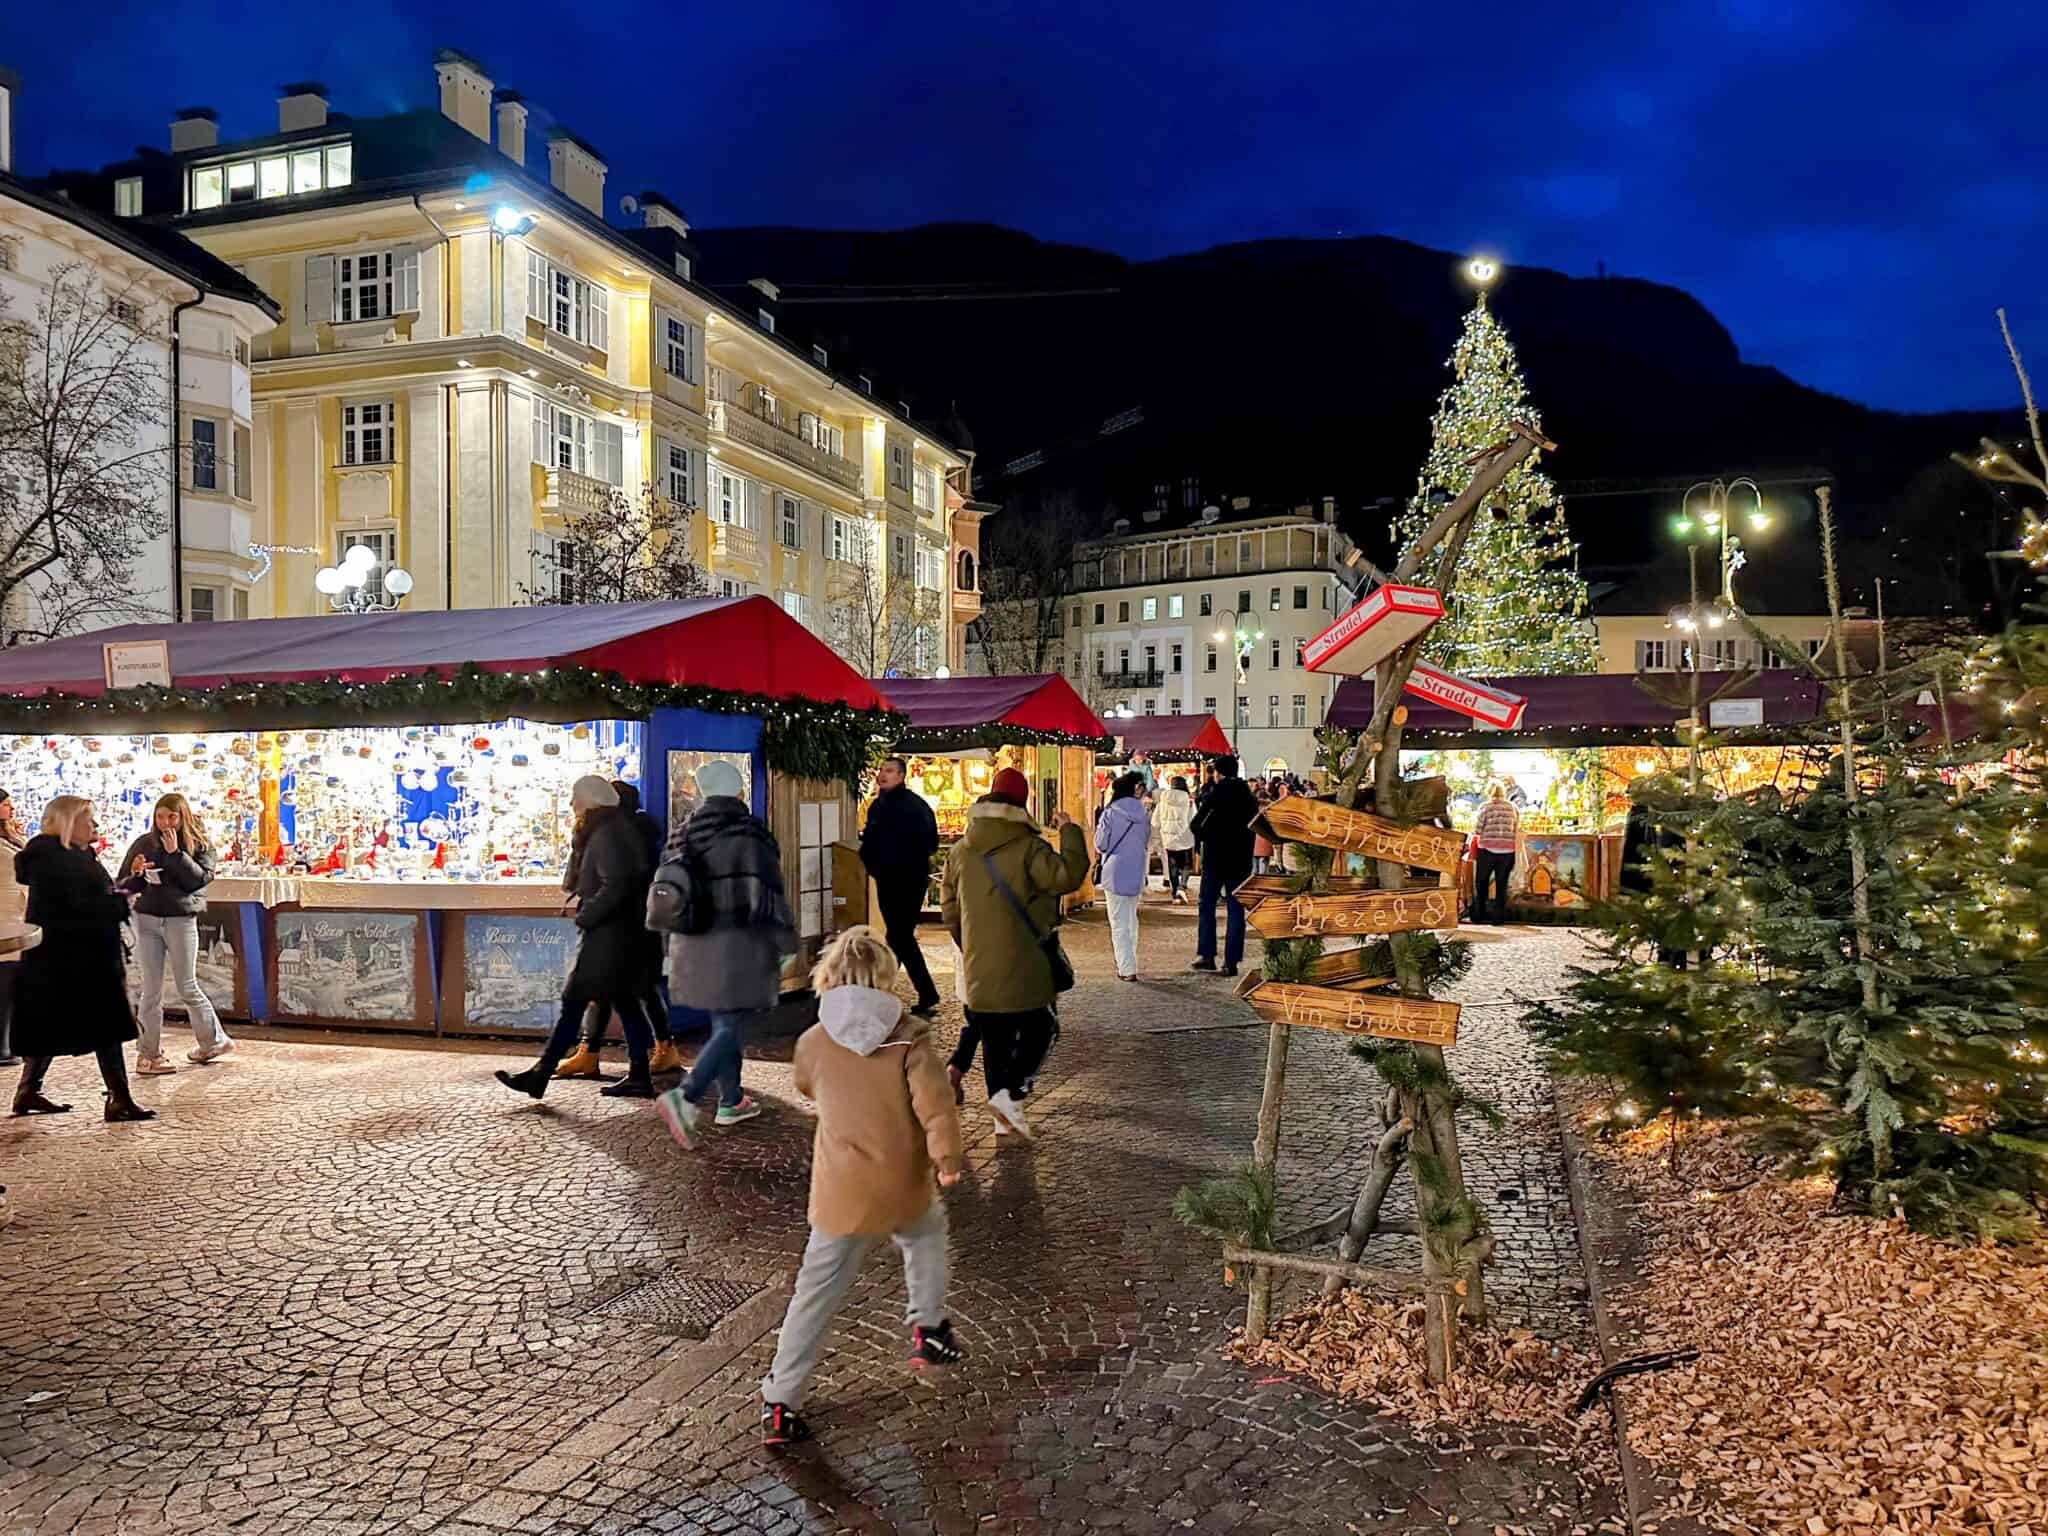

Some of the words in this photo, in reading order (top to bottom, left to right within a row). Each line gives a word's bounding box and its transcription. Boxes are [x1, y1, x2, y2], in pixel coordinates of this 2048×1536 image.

[1322, 611, 1363, 648] Strudel
[1421, 676, 1478, 708] Strudel
[1287, 895, 1408, 932] Brezel
[1280, 989, 1323, 1026] Vin
